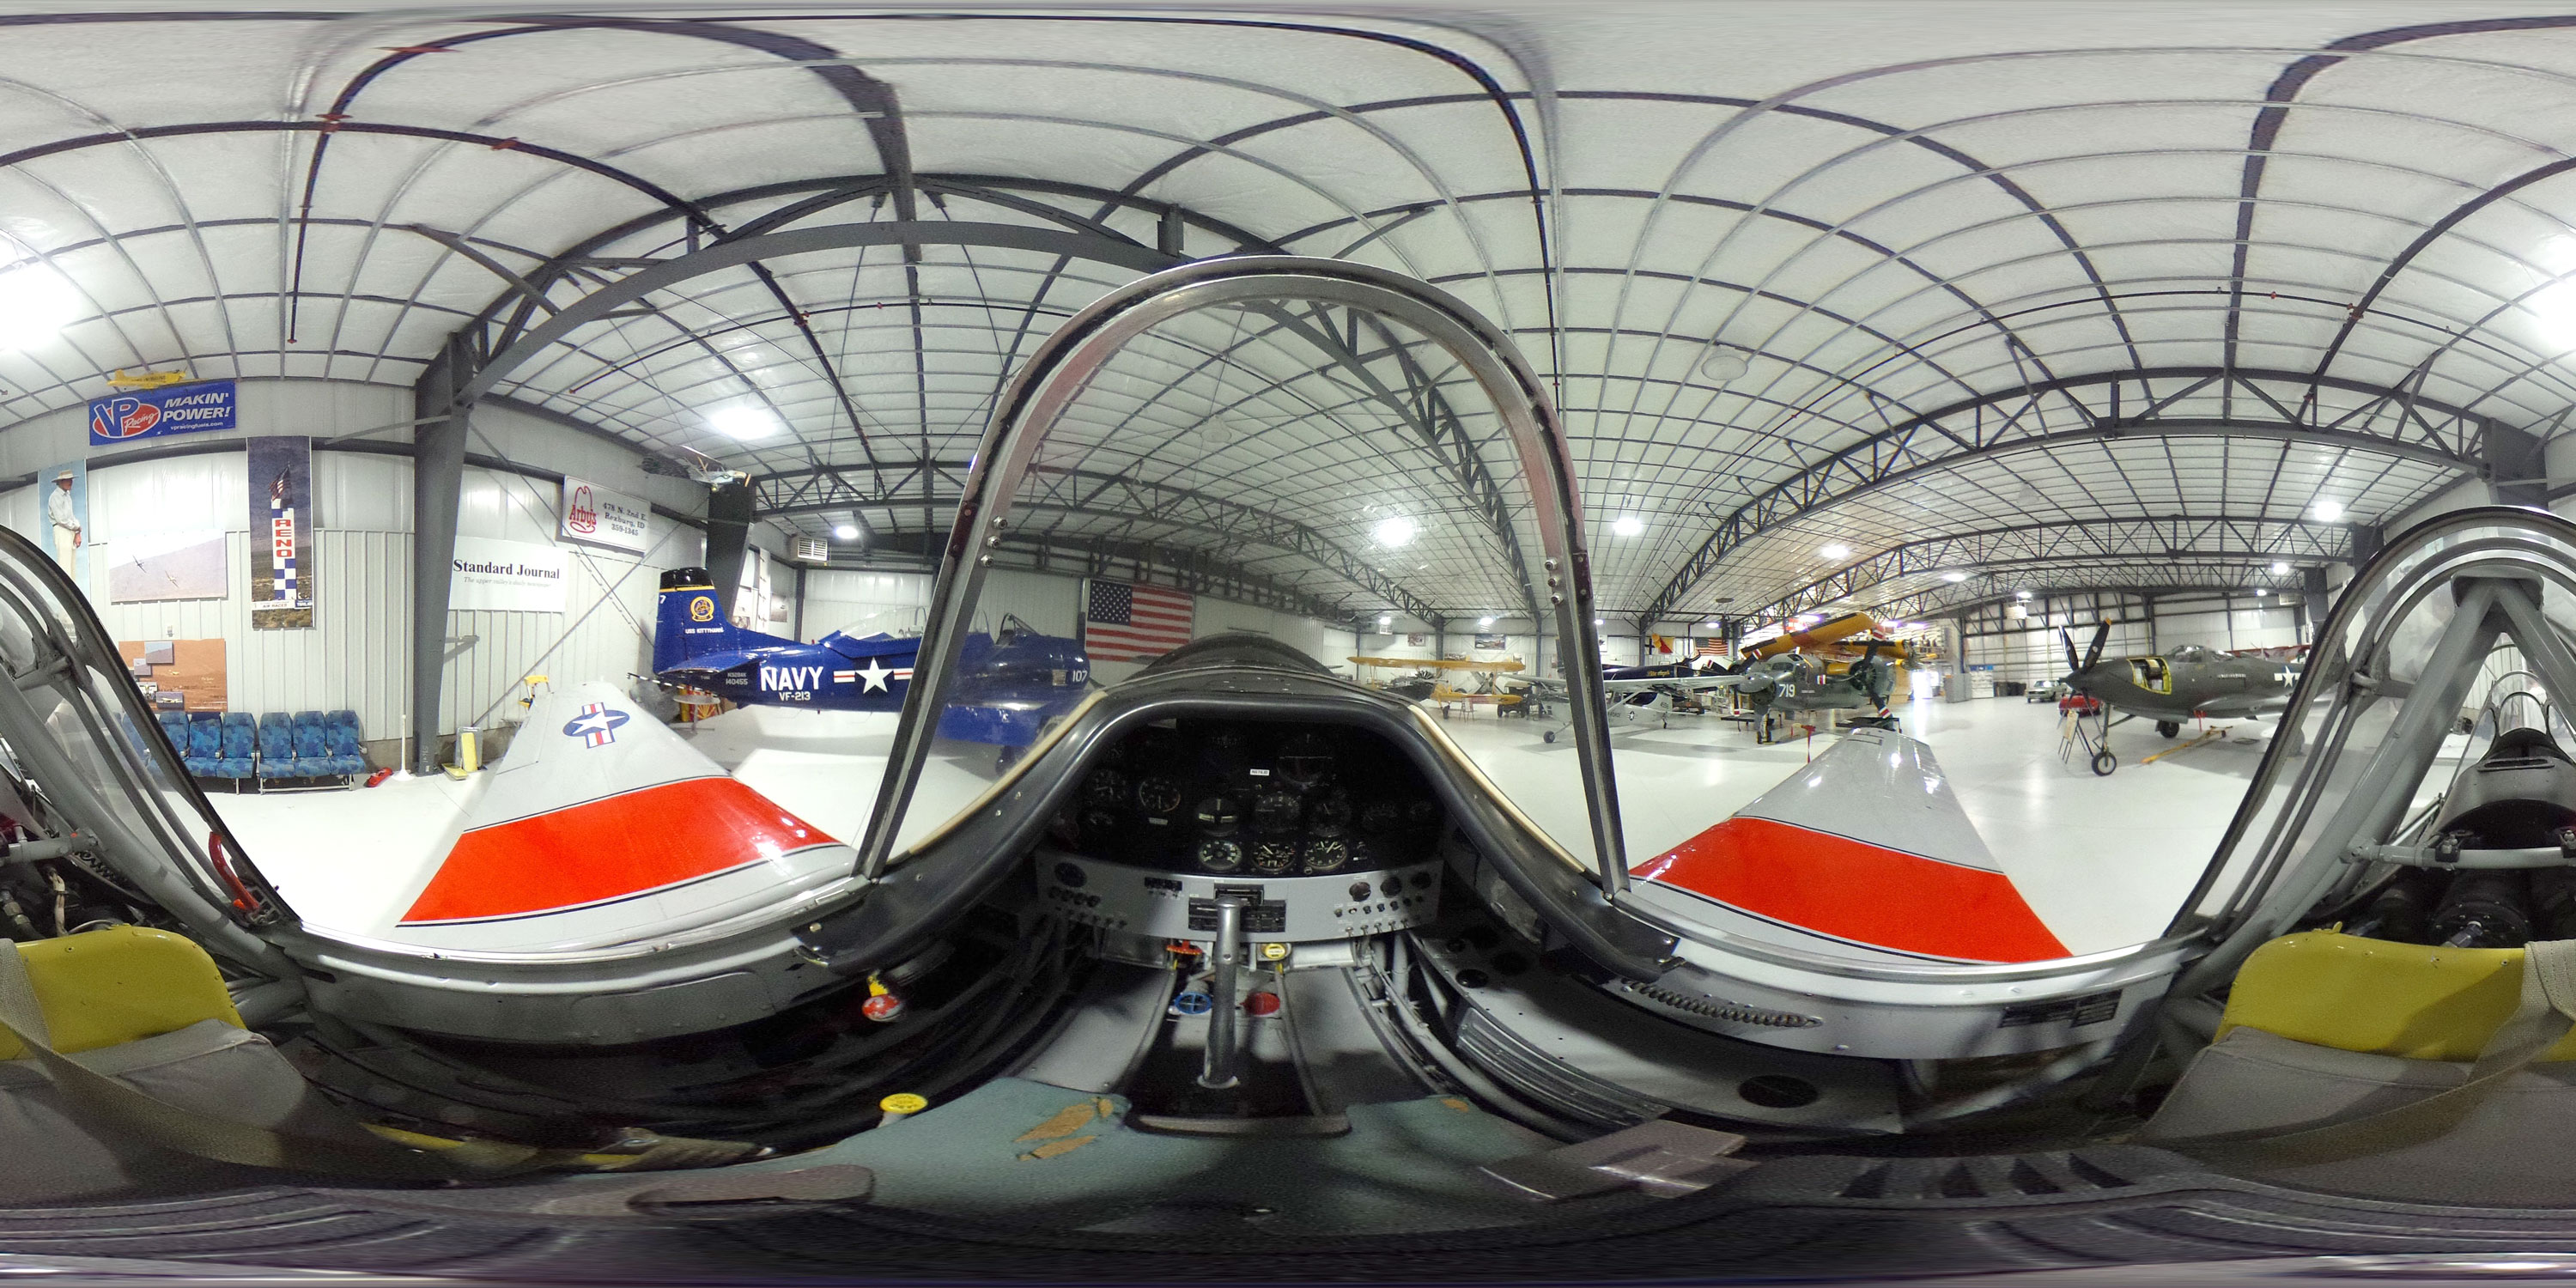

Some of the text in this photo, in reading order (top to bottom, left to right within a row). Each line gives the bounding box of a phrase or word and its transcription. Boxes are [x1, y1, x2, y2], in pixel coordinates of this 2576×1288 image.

[165, 392, 229, 409] MAKIN'
[94, 397, 140, 438] VP
[124, 411, 159, 432] Racing
[162, 407, 231, 422] POWER!
[171, 421, 223, 430] vpracingfuels.com
[568, 505, 597, 527] Arby's
[627, 509, 639, 519] 2nd
[275, 519, 292, 557] RENO
[453, 559, 560, 579] Standard Journal
[659, 595, 666, 604] 7
[760, 666, 823, 691] NAVY
[1072, 670, 1088, 683] 107
[779, 691, 811, 702] VF-213
[1778, 684, 1795, 698] 719
